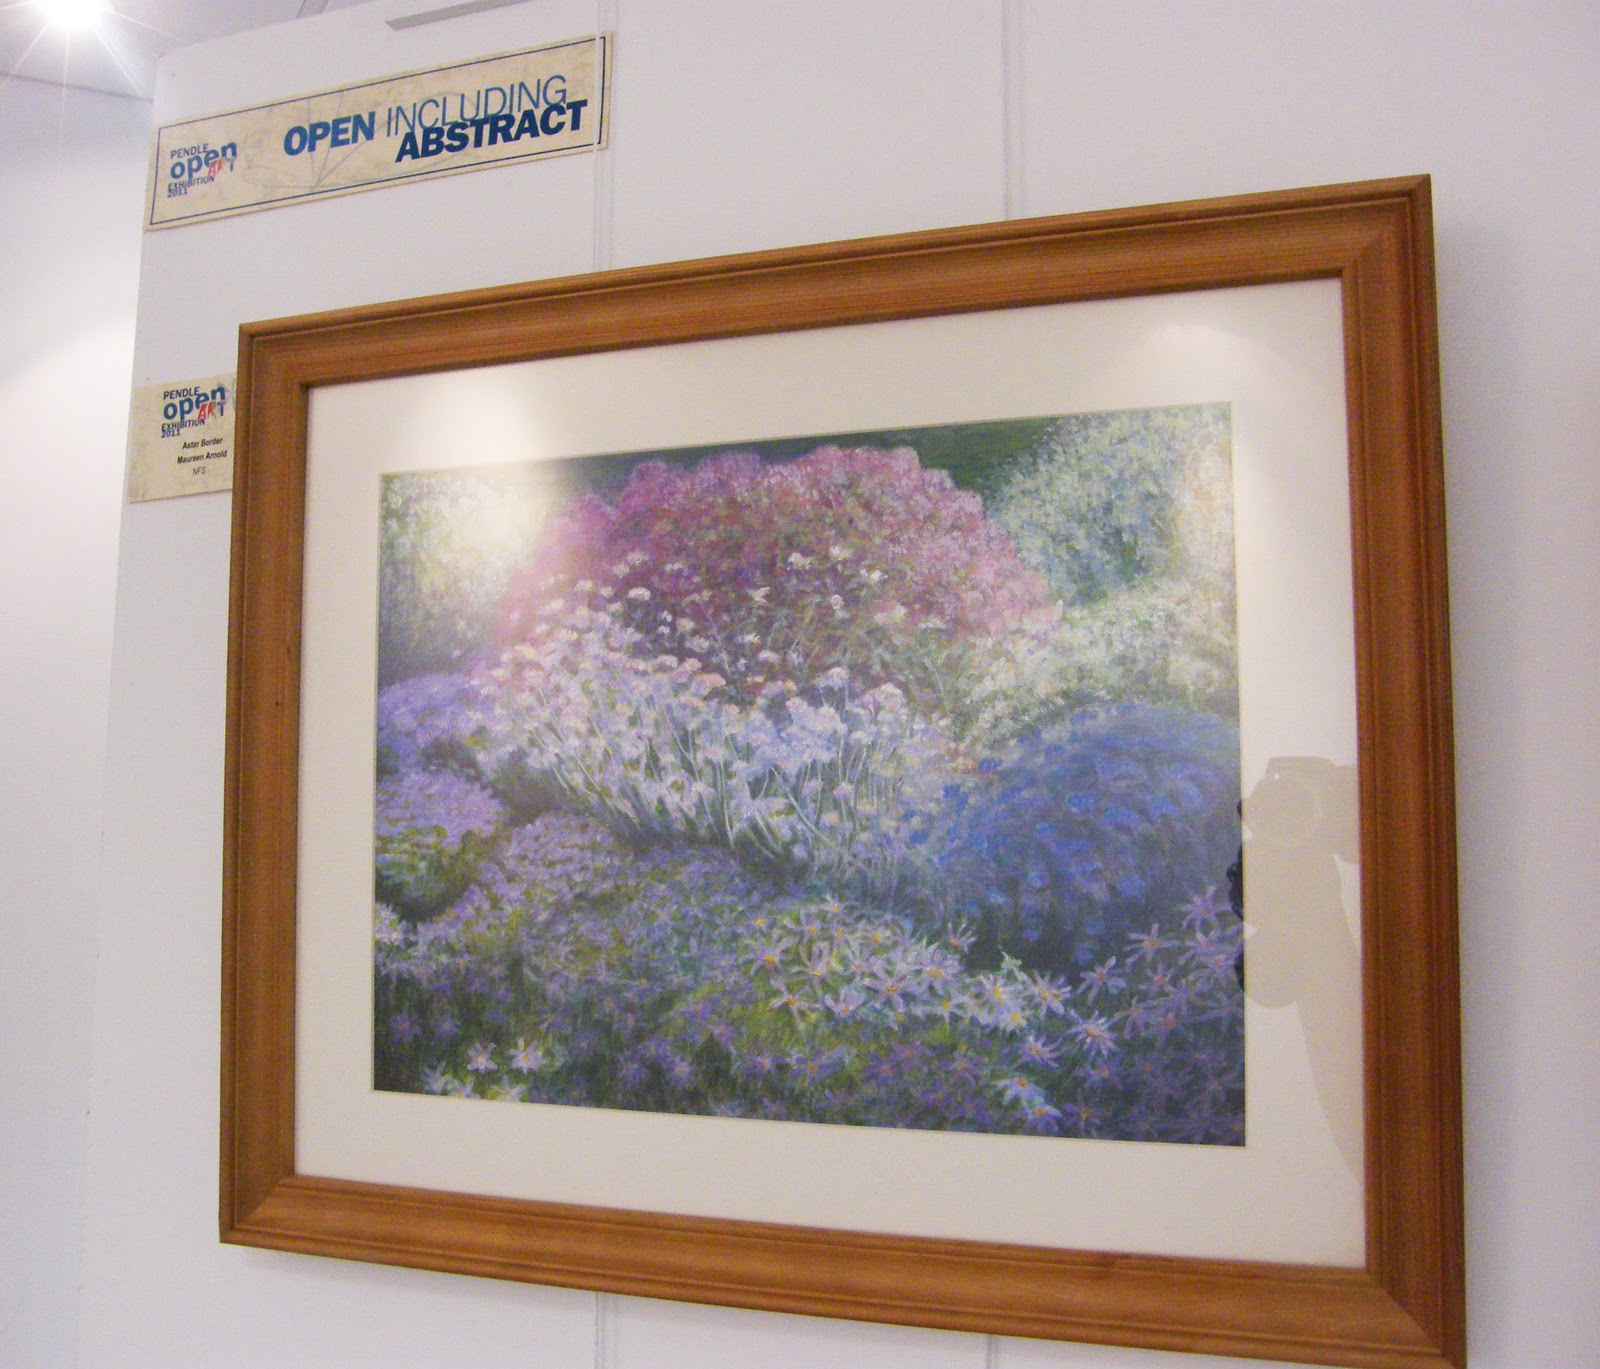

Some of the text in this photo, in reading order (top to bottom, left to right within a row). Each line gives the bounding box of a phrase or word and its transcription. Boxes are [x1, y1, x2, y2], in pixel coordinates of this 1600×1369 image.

[283, 74, 568, 157] OPEN INCLUDING
[395, 99, 588, 163] ABSTRACT
[170, 143, 209, 160] PENDLE
[170, 142, 237, 184] open
[163, 386, 200, 400] PENDLE
[163, 387, 225, 421] open
[161, 419, 205, 430] EXHIBITION
[182, 438, 223, 449] Aster Border
